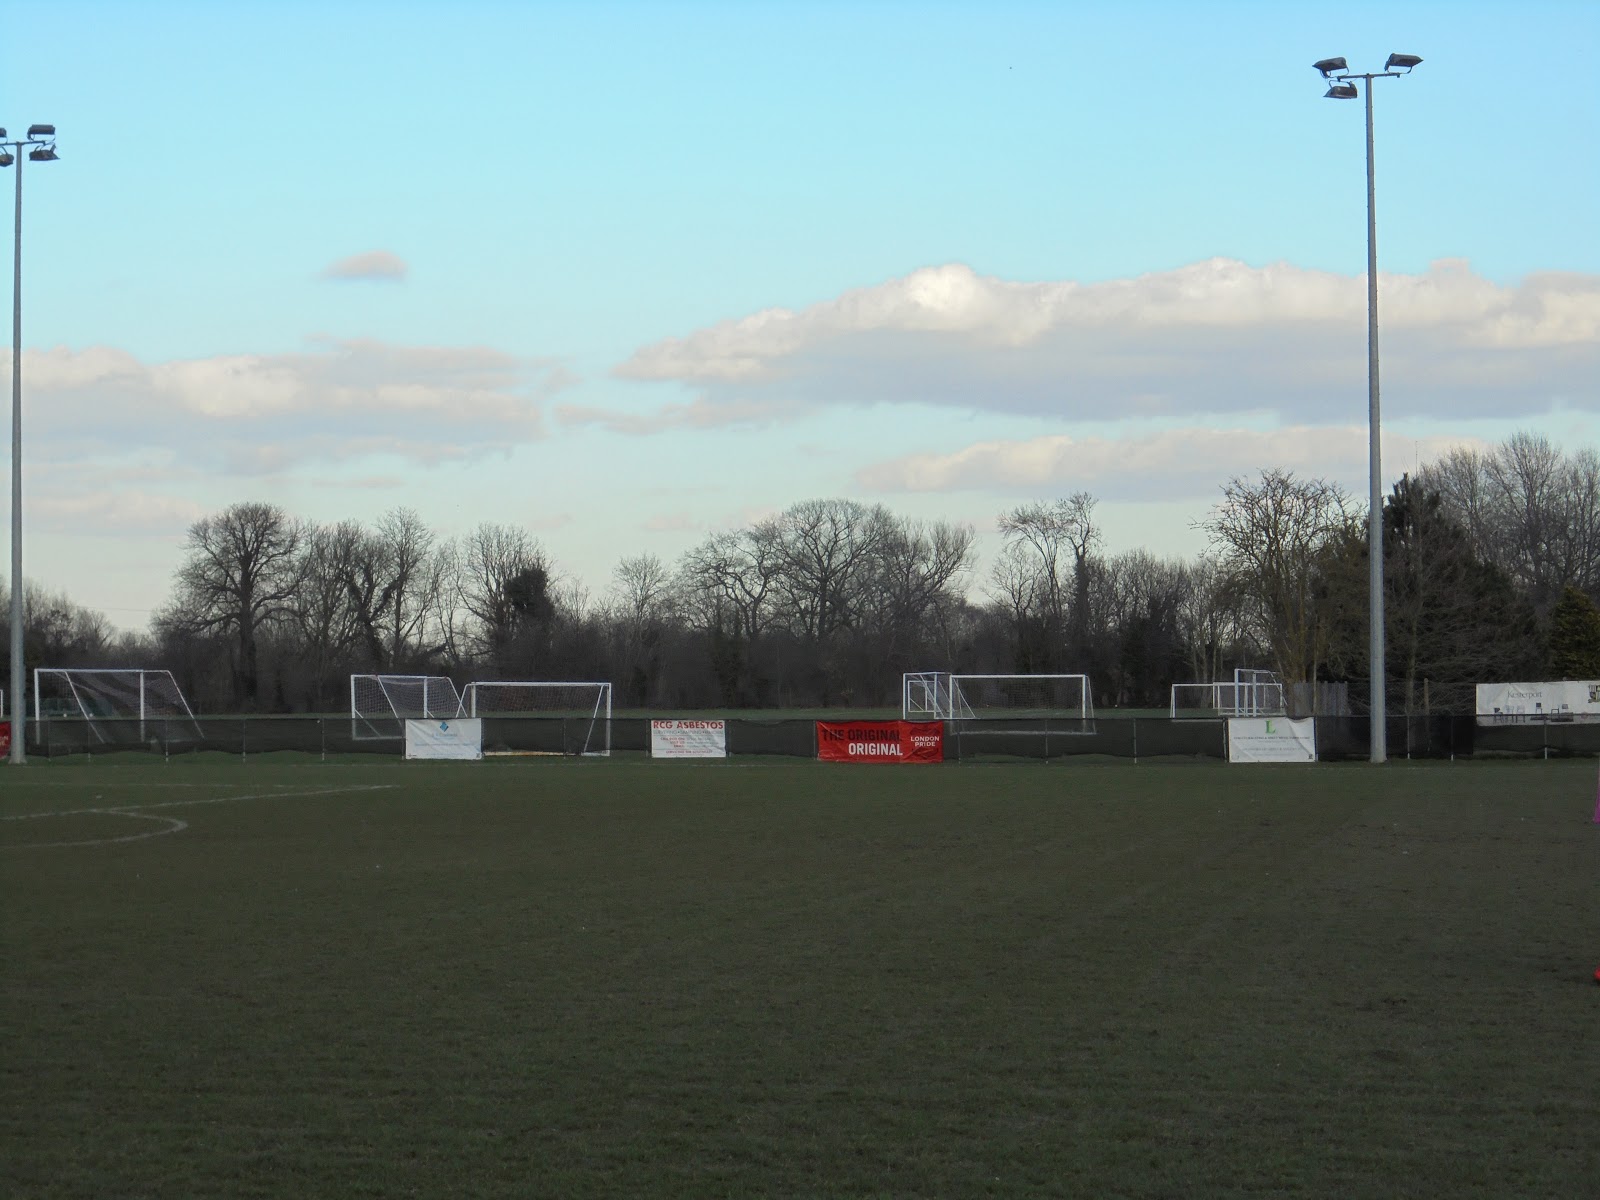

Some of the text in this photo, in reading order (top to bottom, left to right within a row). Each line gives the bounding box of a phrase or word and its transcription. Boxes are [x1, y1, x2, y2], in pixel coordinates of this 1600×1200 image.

[653, 720, 724, 729] RCG ASBESTOS
[1265, 720, 1277, 734] L
[822, 728, 902, 741] THE ORIGINAL
[848, 742, 903, 756] ORIGINAL
